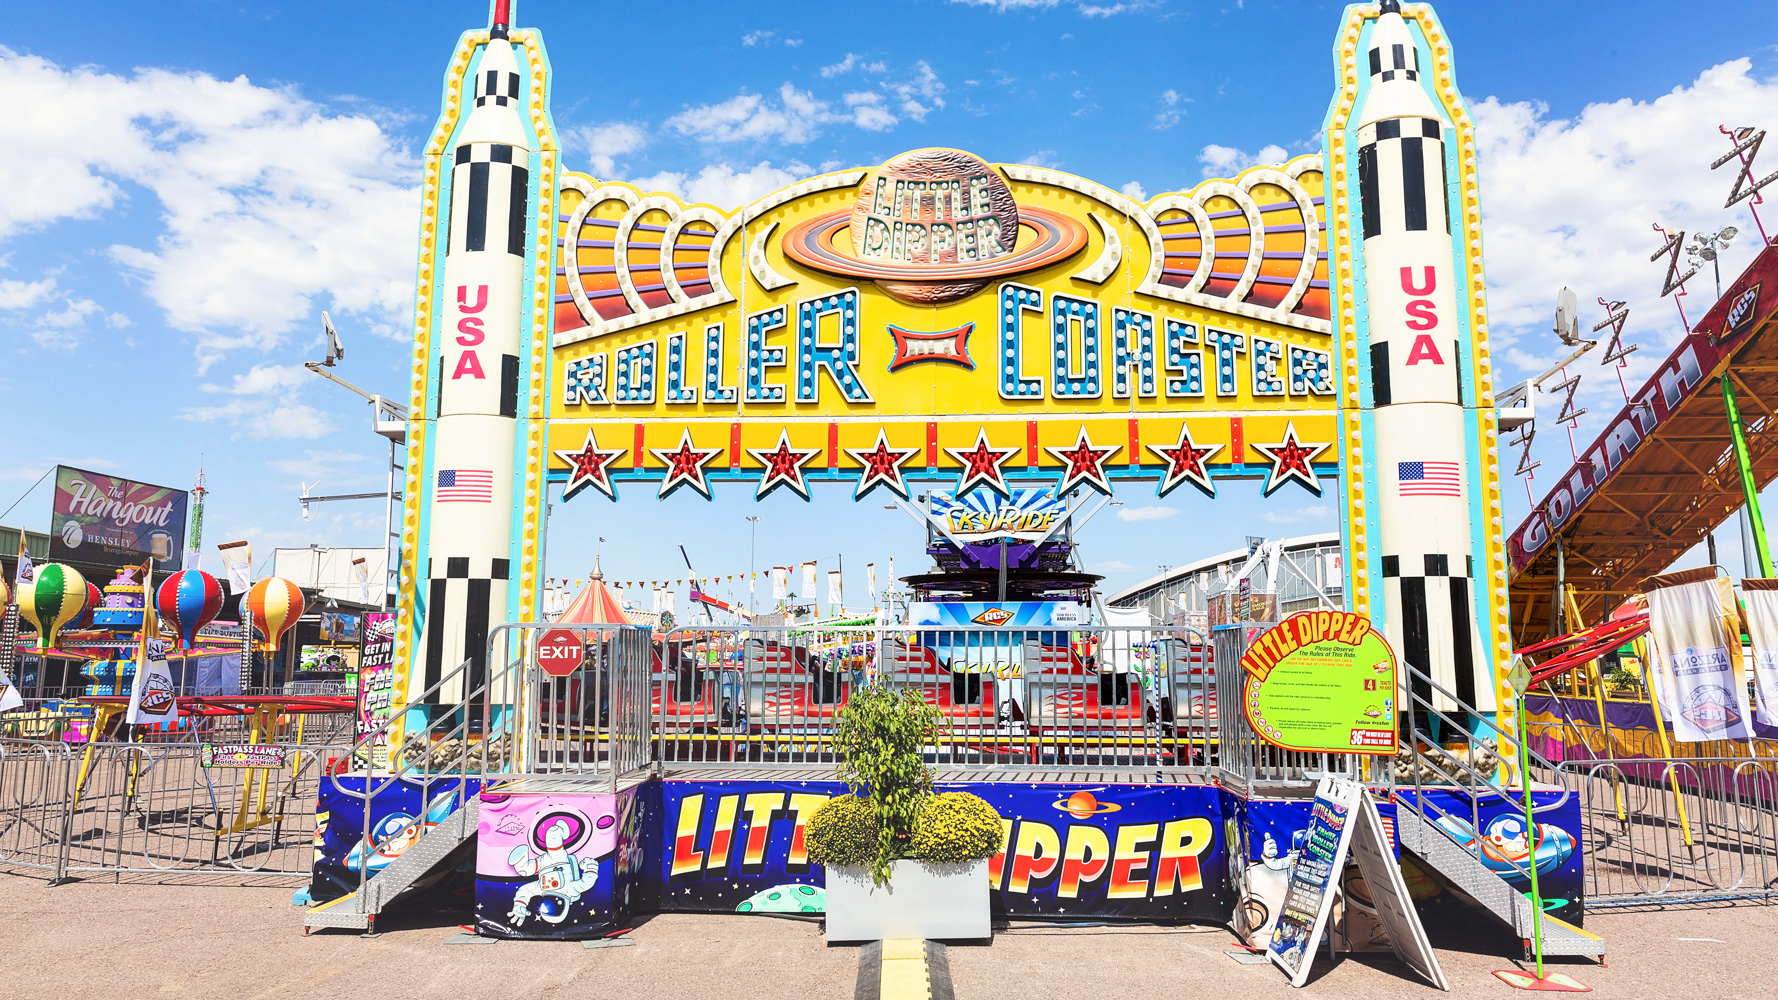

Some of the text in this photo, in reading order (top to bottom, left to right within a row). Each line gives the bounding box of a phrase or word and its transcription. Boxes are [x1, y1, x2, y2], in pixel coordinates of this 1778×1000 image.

[874, 175, 990, 220] LITTLE
[863, 216, 1007, 262] DIPPER
[1400, 266, 1445, 366] USA
[1726, 289, 1756, 328] RCS
[452, 285, 488, 380] USA
[564, 280, 1337, 406] ROLLER COASTER
[1522, 343, 1702, 552] GOLIATH
[69, 479, 174, 527] Hangout
[108, 485, 124, 499] The
[88, 534, 131, 548] HENSLEY
[984, 610, 1008, 622] RCS
[364, 642, 391, 655] GET IN
[539, 646, 581, 659] EXIT
[1241, 620, 1299, 682] LITTLE
[1296, 612, 1370, 646] DIPPER
[362, 655, 384, 668] FAST
[1367, 680, 1373, 690] 4
[213, 745, 278, 755] FASTPASS LANE
[1311, 802, 1345, 831] LITTLE DIPPER
[1312, 835, 1333, 851] ROLLER
[1317, 826, 1336, 841] FAMILY
[988, 816, 1212, 899] IPPER
[1309, 844, 1332, 860] COASTER
